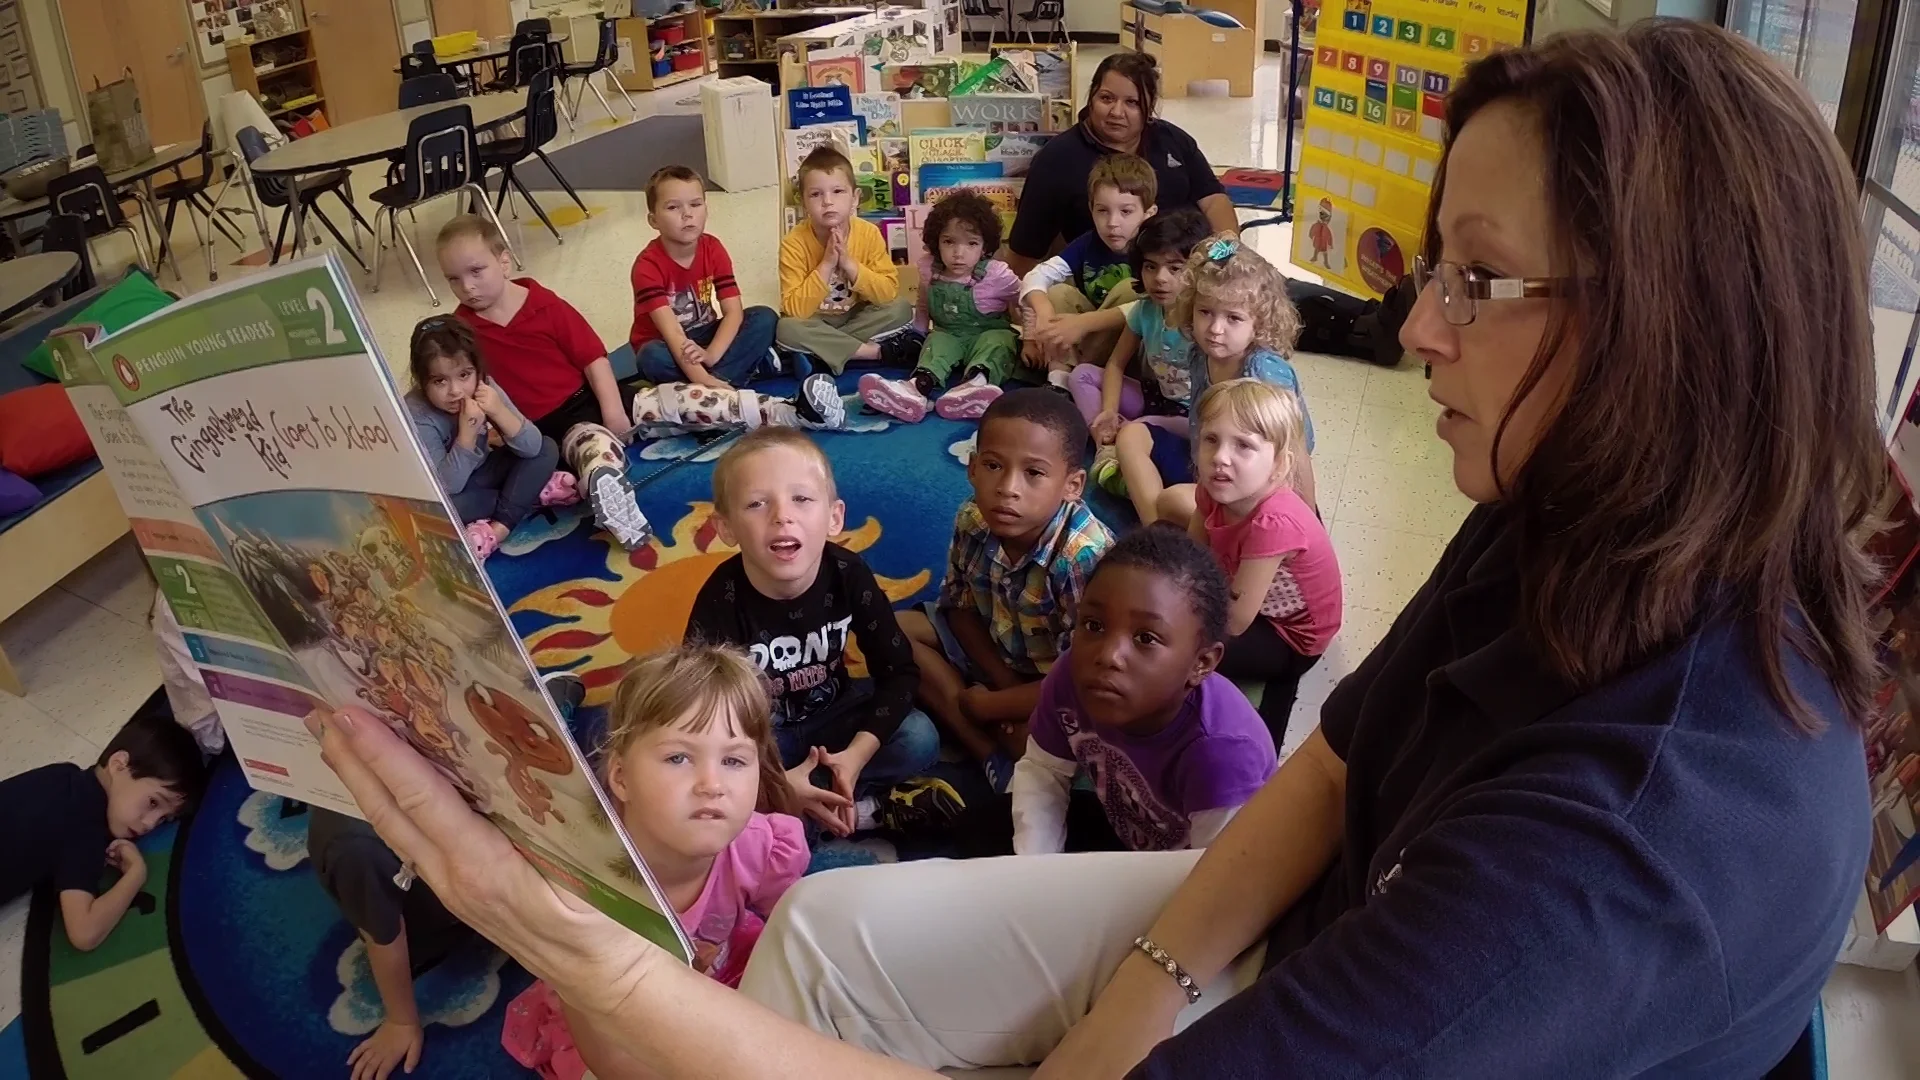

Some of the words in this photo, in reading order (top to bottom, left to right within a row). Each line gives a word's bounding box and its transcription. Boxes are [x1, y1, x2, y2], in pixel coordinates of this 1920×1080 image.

[1379, 20, 1388, 33] 2
[1405, 26, 1415, 39] 3
[1436, 31, 1447, 45] 4
[1469, 39, 1480, 52] 5
[1325, 51, 1332, 61] 7
[1348, 57, 1357, 70] 8
[1374, 63, 1383, 76] 9
[1400, 69, 1416, 84] 10
[1428, 75, 1443, 91] 11
[953, 103, 1040, 121] WORK
[1318, 91, 1331, 104] 14
[1341, 97, 1354, 112] 15
[1367, 102, 1381, 118] 16
[1396, 112, 1412, 126] 17
[278, 298, 307, 316] LEVEL
[306, 287, 347, 346] 2
[135, 345, 187, 375] PENGUIN
[185, 331, 227, 356] YOUNG
[226, 319, 276, 345] READERS
[52, 348, 73, 381] 2
[160, 395, 196, 426] The
[244, 433, 292, 480] Kid
[269, 409, 319, 450] Goes
[306, 405, 337, 448] to
[329, 405, 399, 453] School
[175, 563, 198, 595] 2
